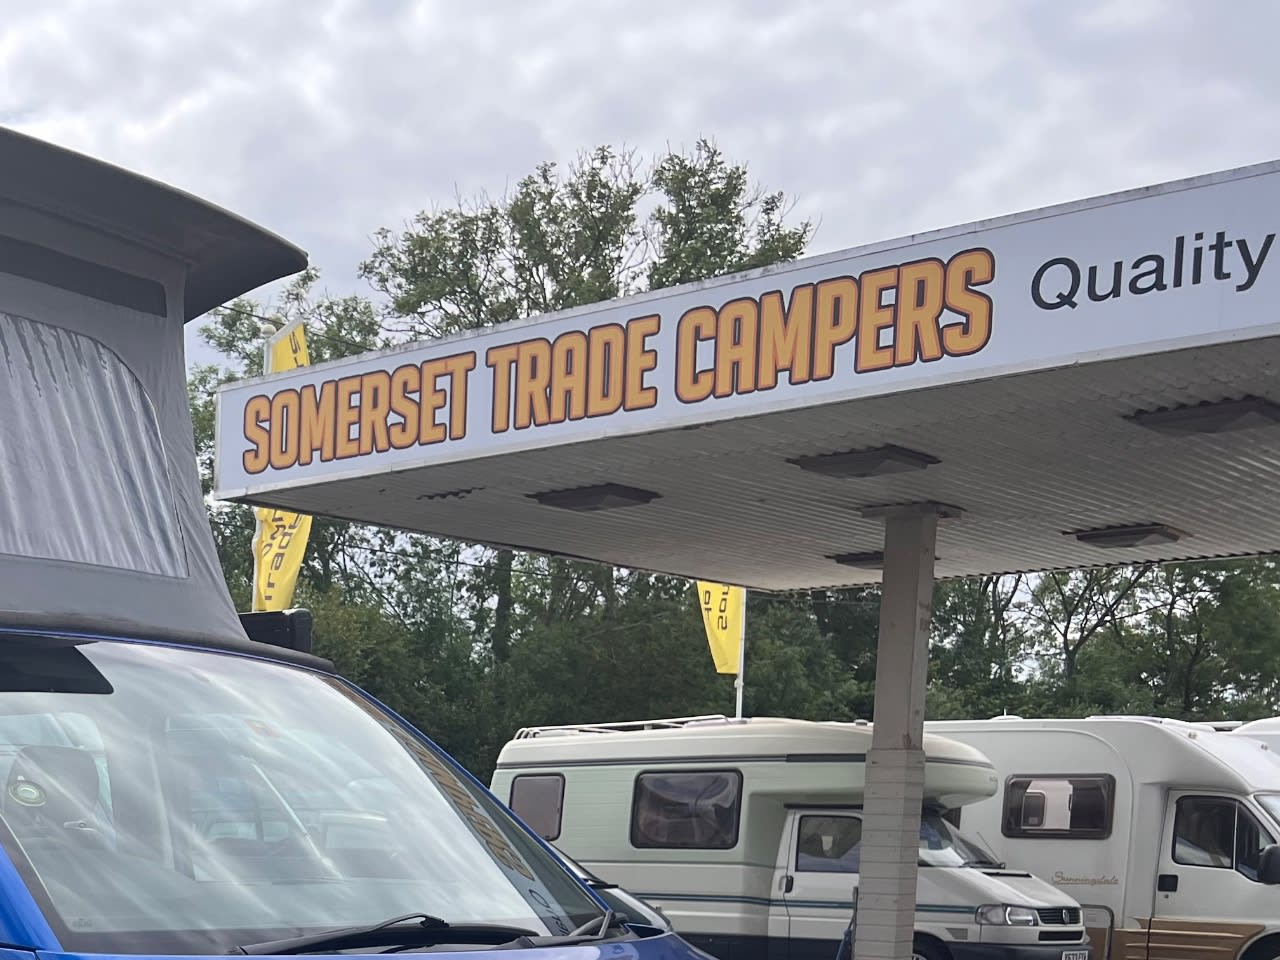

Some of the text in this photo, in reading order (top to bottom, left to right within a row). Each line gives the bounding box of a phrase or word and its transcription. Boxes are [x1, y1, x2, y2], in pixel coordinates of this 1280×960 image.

[1029, 231, 1277, 311] Quality
[242, 246, 996, 475] SOMERSET TRADE CAMPERS
